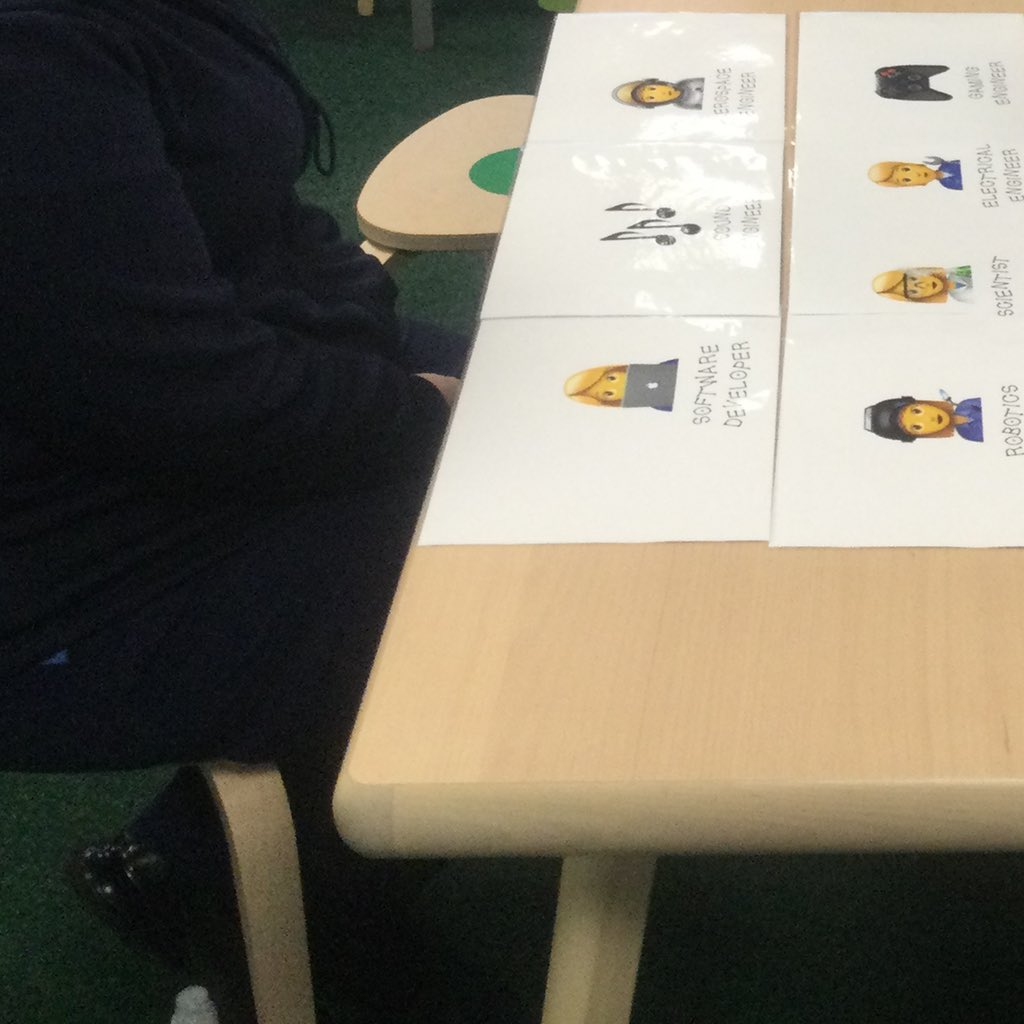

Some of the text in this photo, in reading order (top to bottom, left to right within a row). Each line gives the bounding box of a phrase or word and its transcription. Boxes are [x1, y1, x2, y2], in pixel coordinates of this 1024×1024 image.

[713, 67, 732, 116] EROSPACE
[965, 66, 985, 100] GAMING
[989, 61, 1011, 106] ENGINEER
[976, 143, 999, 208] ELECTRICAL
[991, 255, 1014, 317] SCIENTIST
[692, 344, 720, 425] SOFTWARE
[722, 341, 751, 428] DEVELOPER
[1001, 384, 1024, 457] ROBOTICS
